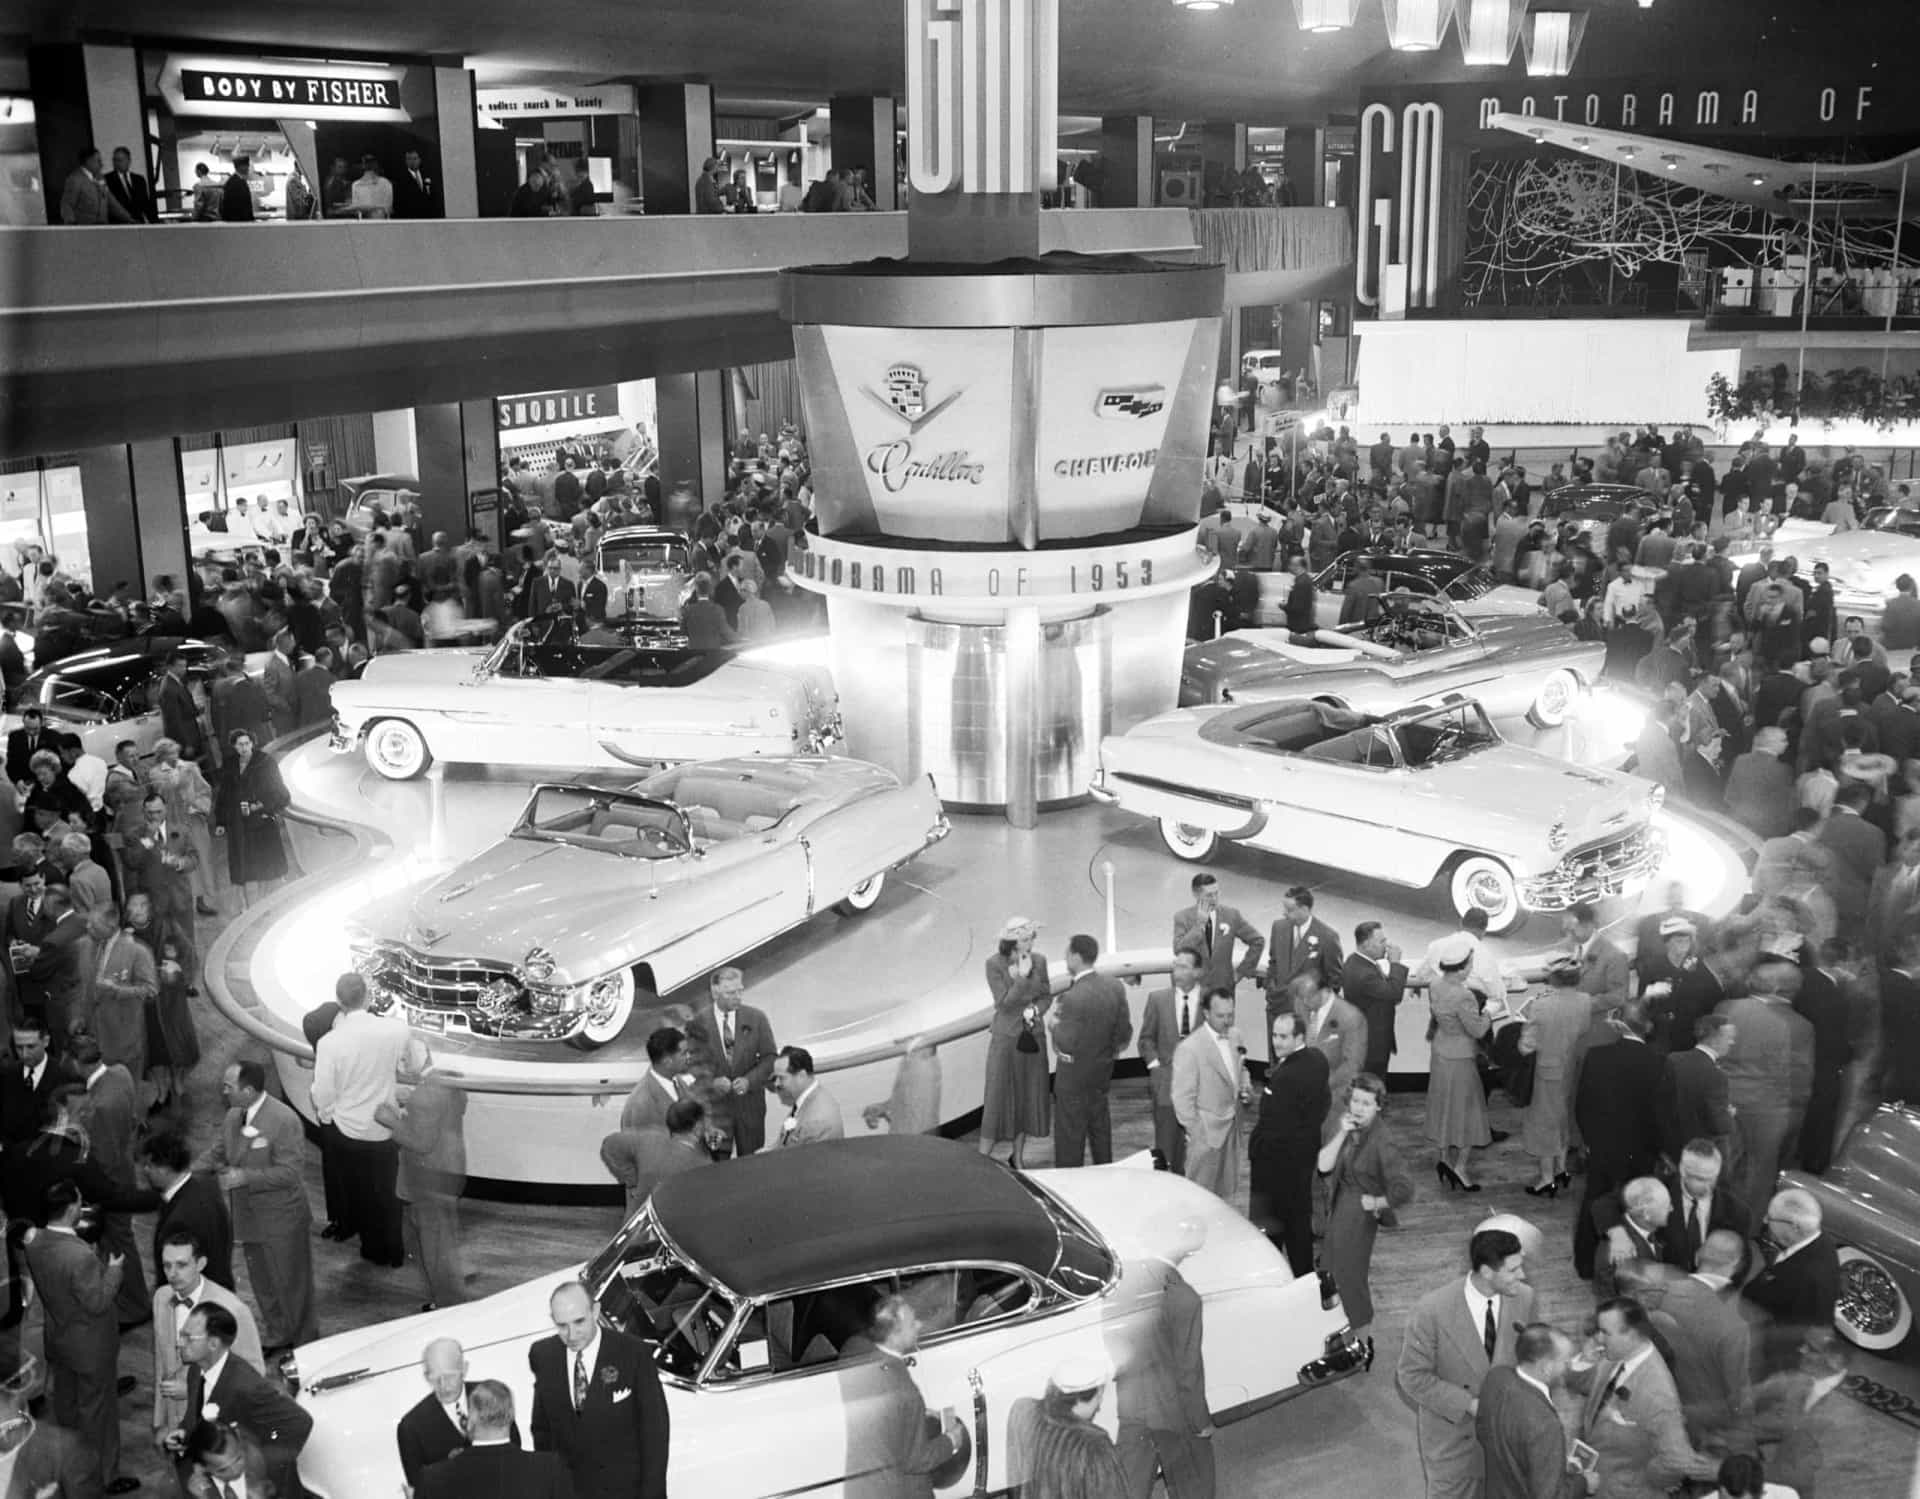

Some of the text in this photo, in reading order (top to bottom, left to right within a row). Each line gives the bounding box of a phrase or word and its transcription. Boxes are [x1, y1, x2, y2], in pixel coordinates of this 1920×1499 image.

[203, 76, 390, 105] BODY BY FISHER
[488, 101, 517, 111] endless
[524, 99, 550, 110] search
[556, 98, 568, 109] for
[574, 97, 602, 109] beauty
[1480, 86, 1873, 129] MOTORAMA OF
[1357, 103, 1443, 308] GM
[867, 439, 985, 492] Cadillac
[988, 567, 1027, 597] OF
[1070, 559, 1154, 594] 1953
